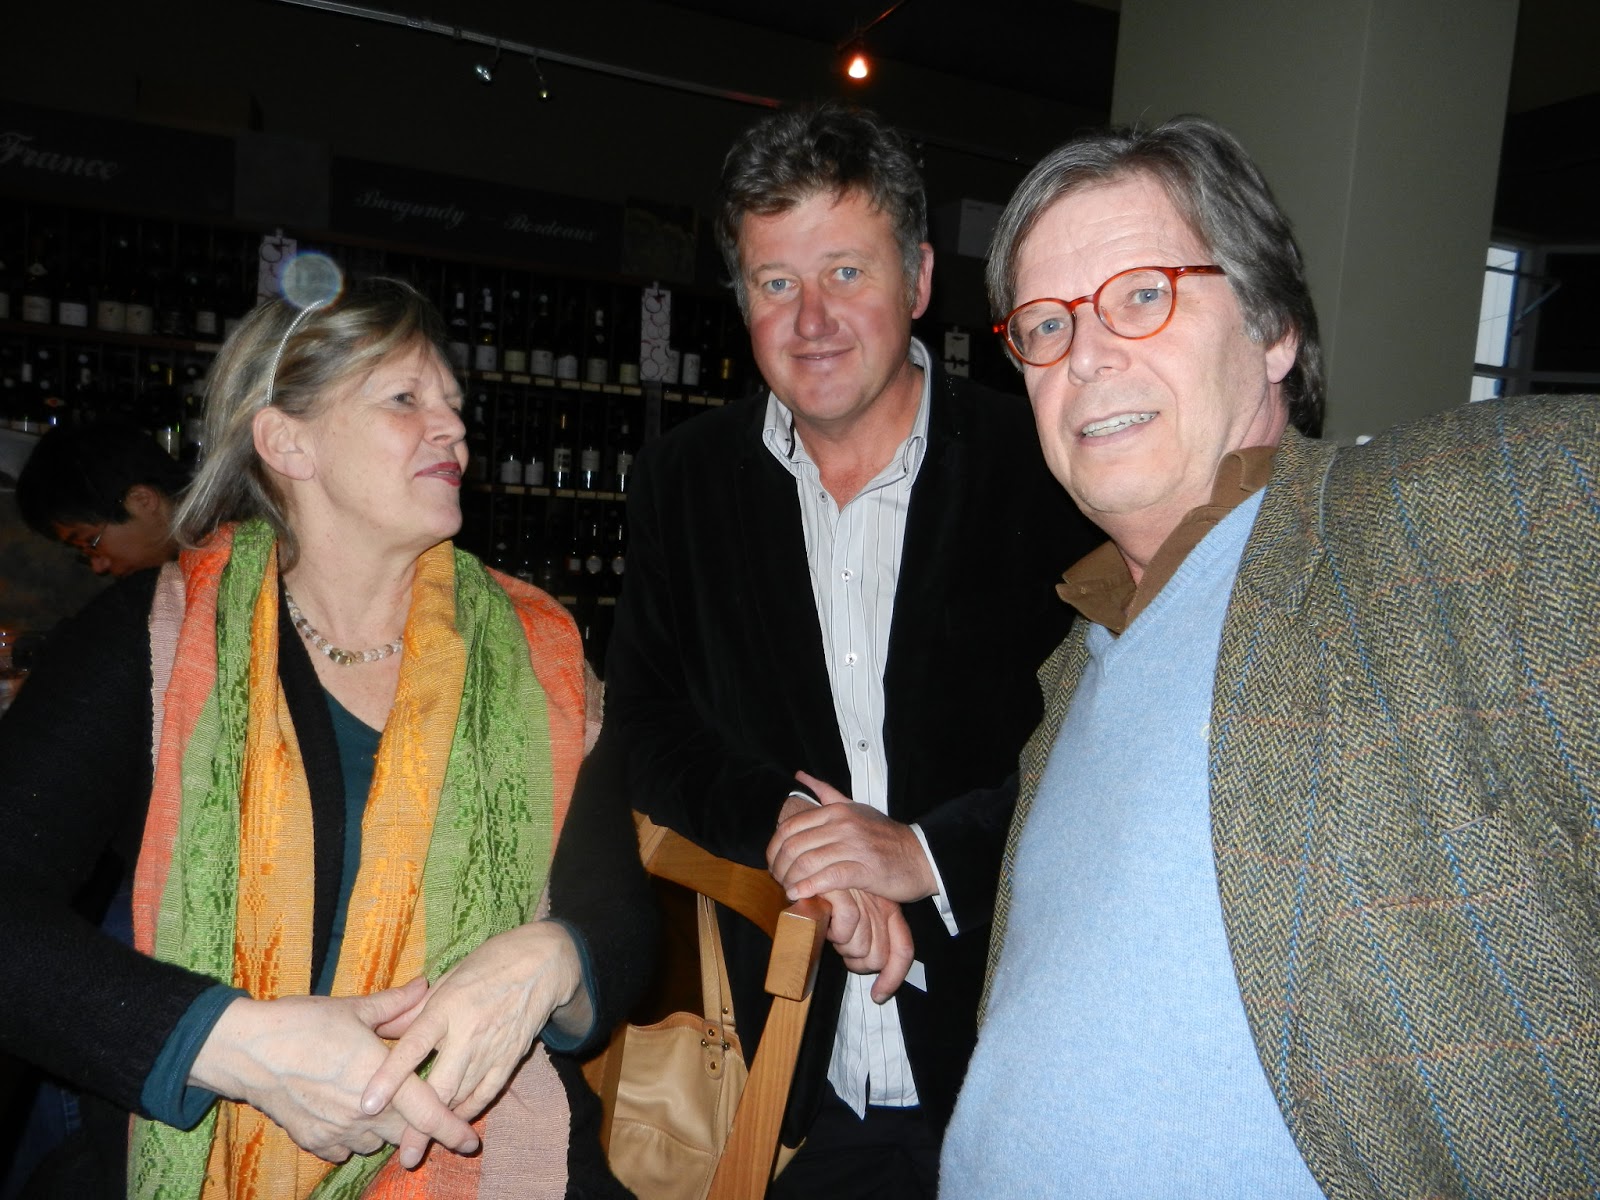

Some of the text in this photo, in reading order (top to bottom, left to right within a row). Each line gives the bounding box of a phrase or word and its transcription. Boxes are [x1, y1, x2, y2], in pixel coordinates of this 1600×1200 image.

[0, 131, 120, 182] France
[353, 189, 466, 231] Burgundy
[503, 211, 598, 242] Bordeaux
